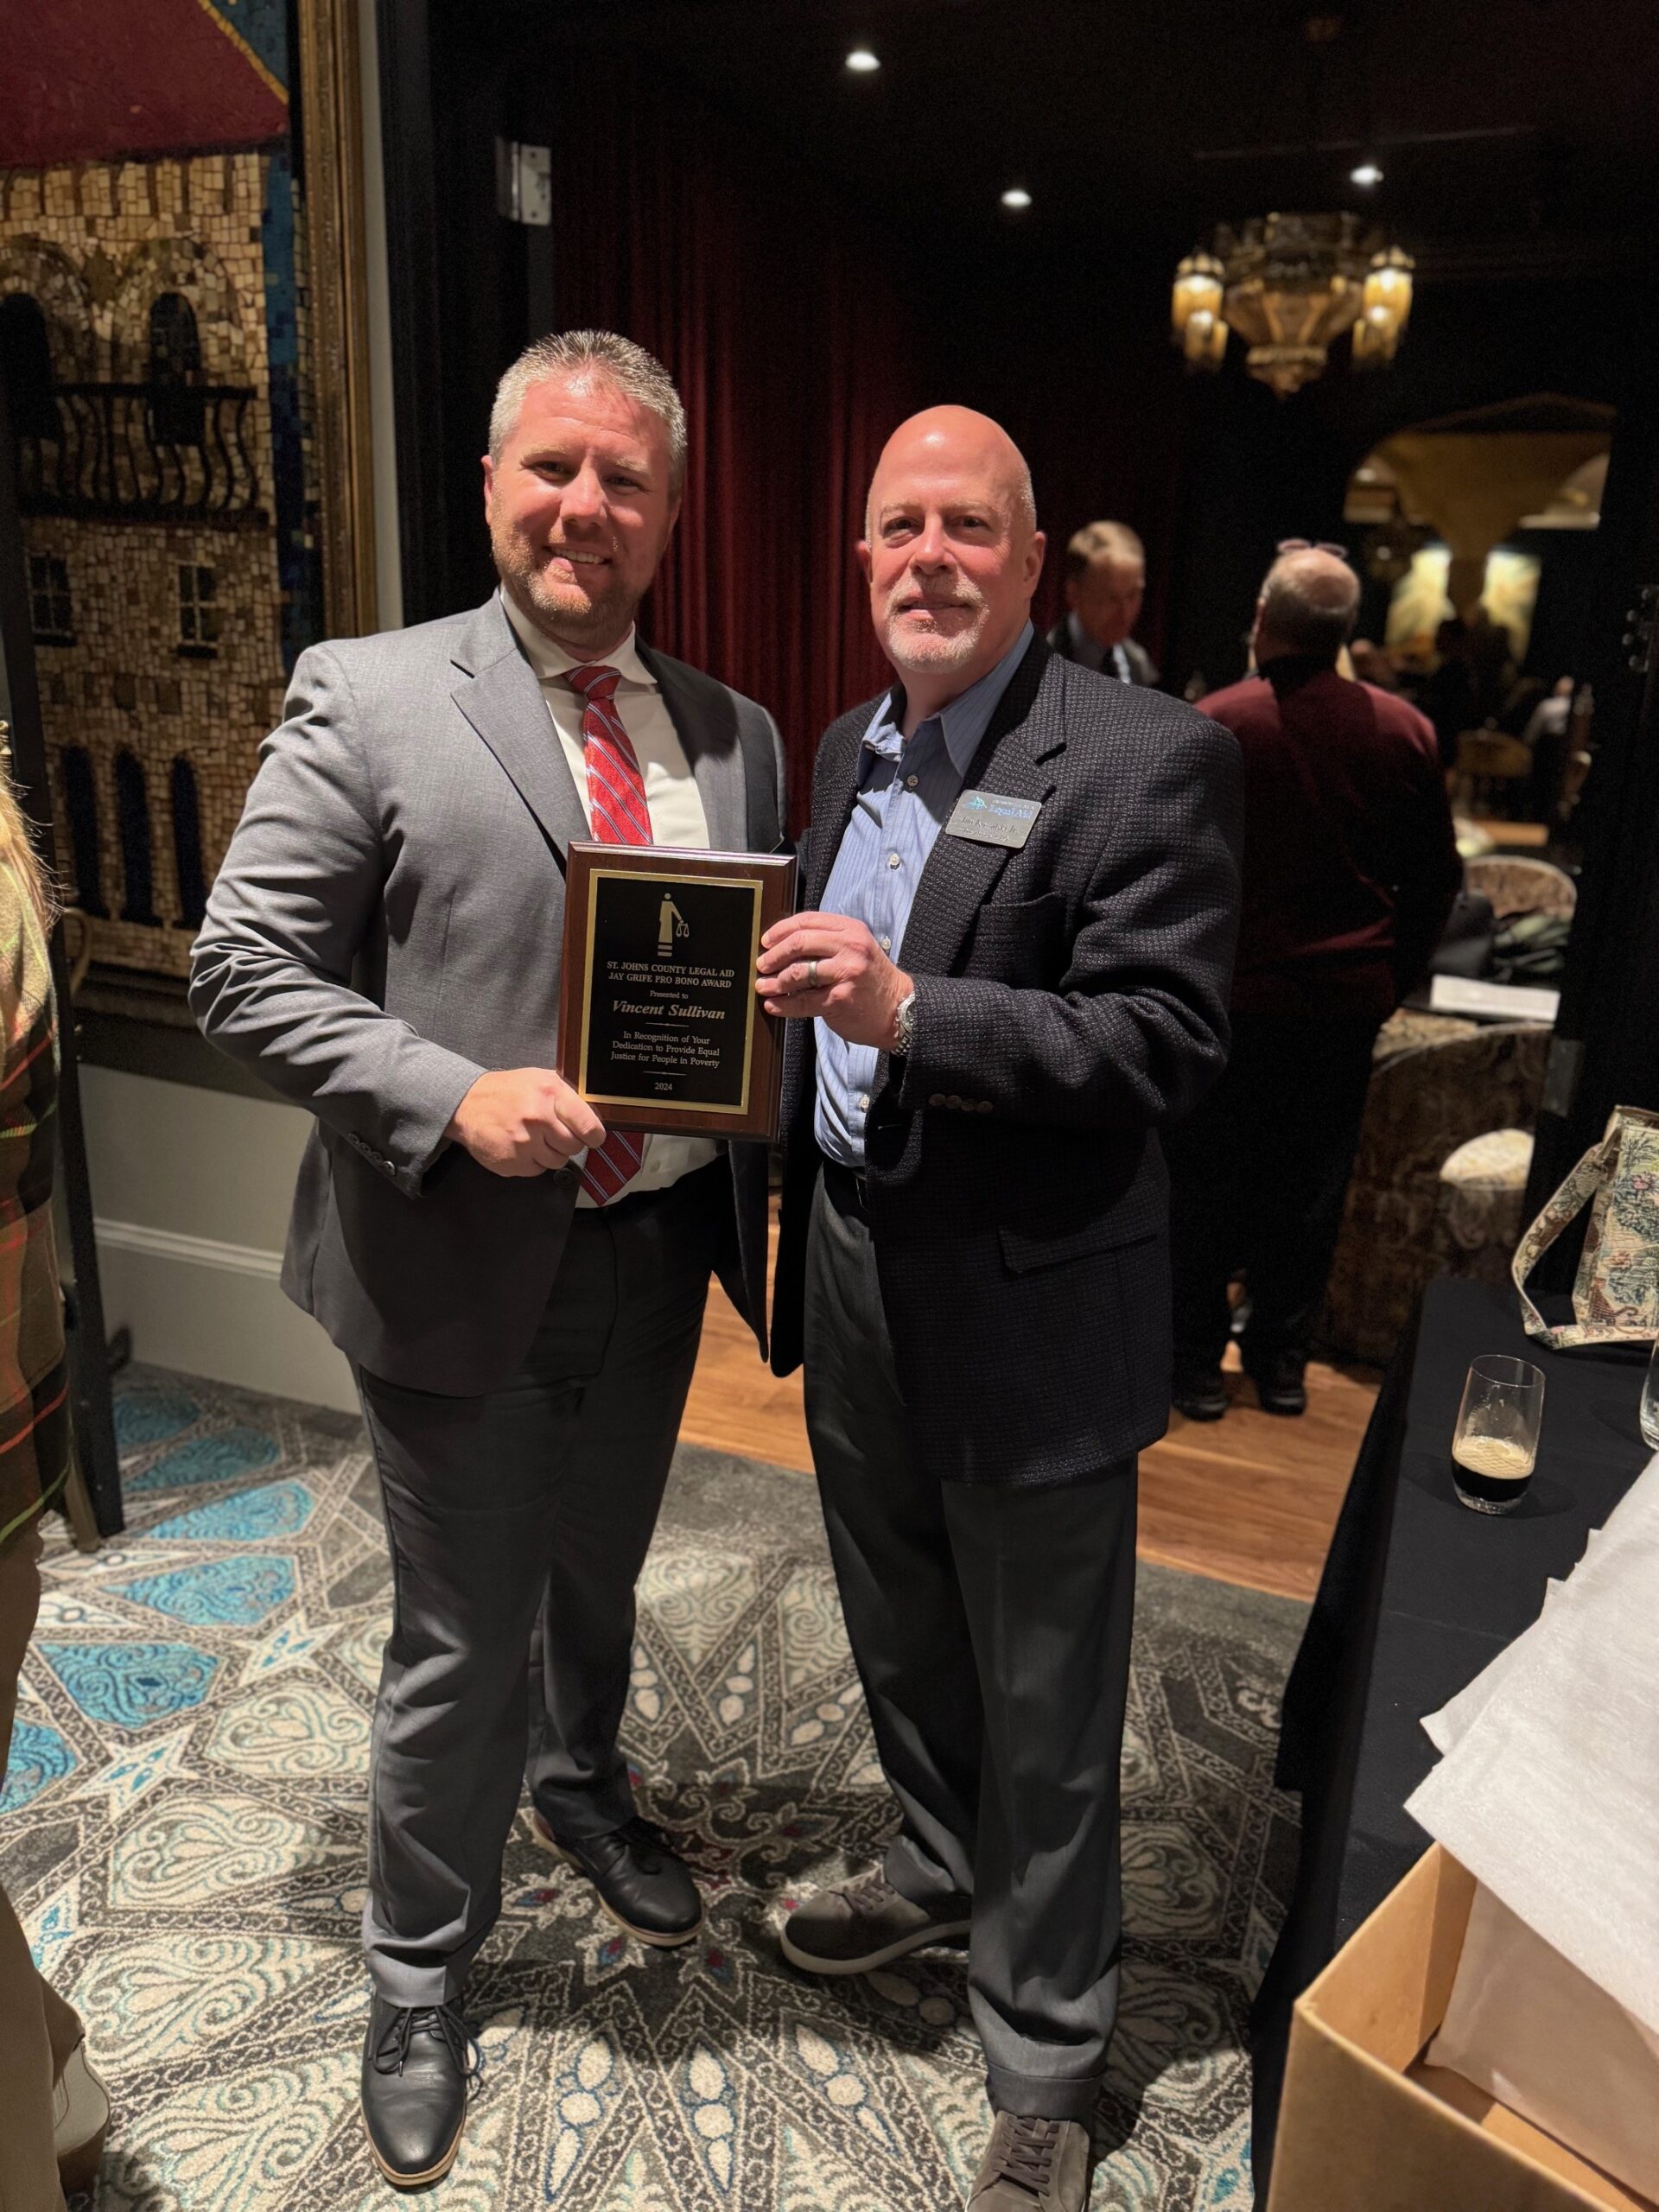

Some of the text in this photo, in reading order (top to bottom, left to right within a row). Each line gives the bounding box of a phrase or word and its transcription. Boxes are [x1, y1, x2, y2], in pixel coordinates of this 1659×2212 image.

[621, 963, 649, 971] JOHNS
[652, 964, 687, 974] COUNTY
[689, 967, 718, 976] LEGAL
[626, 974, 652, 982] GRIFE
[655, 976, 672, 984] PRO
[675, 977, 699, 986] BONO
[701, 979, 732, 988] AWARD
[650, 990, 680, 999] Presented
[613, 1001, 725, 1020] Vincent Sullivan
[634, 1032, 678, 1043] Recognition
[692, 1036, 710, 1045] Your
[613, 1041, 653, 1051] Dedication
[666, 1045, 696, 1054] Provide
[698, 1047, 720, 1057] Equal
[611, 1052, 636, 1060] Justice
[652, 1055, 677, 1065] People
[690, 1058, 720, 1069] Poverty
